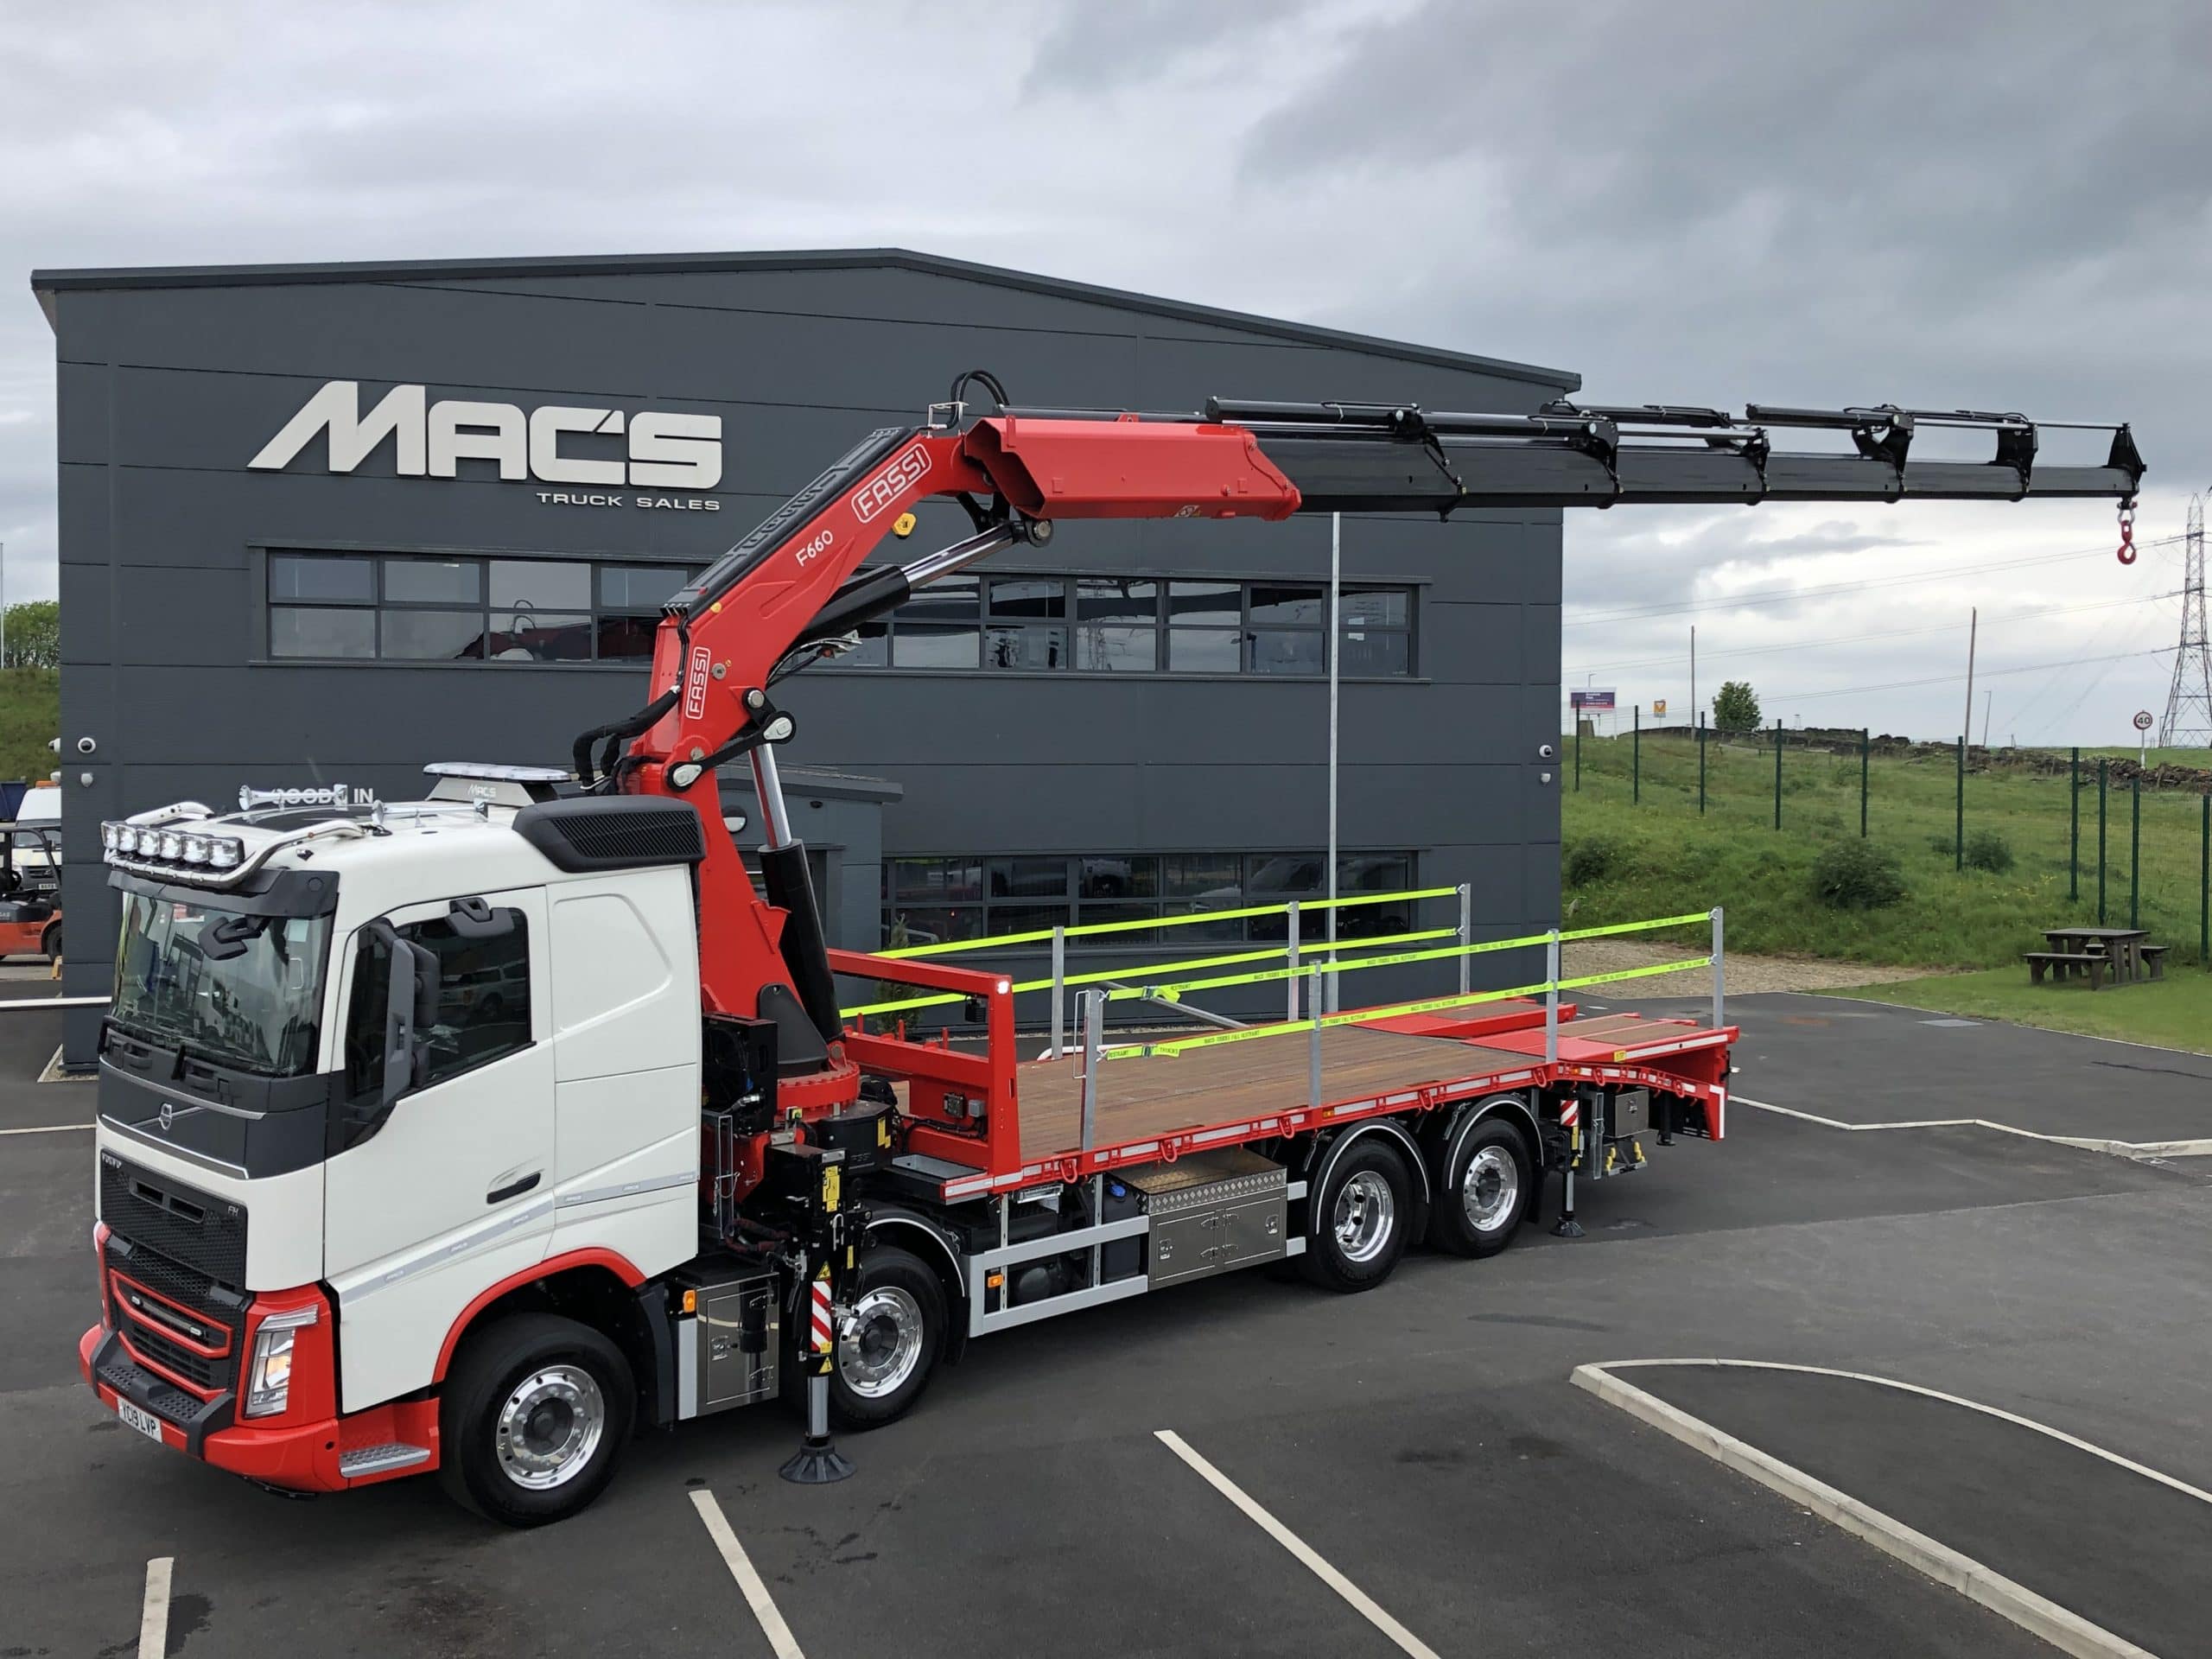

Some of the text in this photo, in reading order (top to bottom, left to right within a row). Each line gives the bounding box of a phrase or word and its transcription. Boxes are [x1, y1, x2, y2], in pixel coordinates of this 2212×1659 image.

[856, 448, 927, 518] FASSI
[536, 492, 721, 512] TRUCK SALES
[795, 530, 834, 567] F660
[689, 652, 709, 715] FASSI
[272, 787, 373, 804] OOD IN
[227, 1205, 239, 1217] FH
[139, 1412, 156, 1436] LVP
